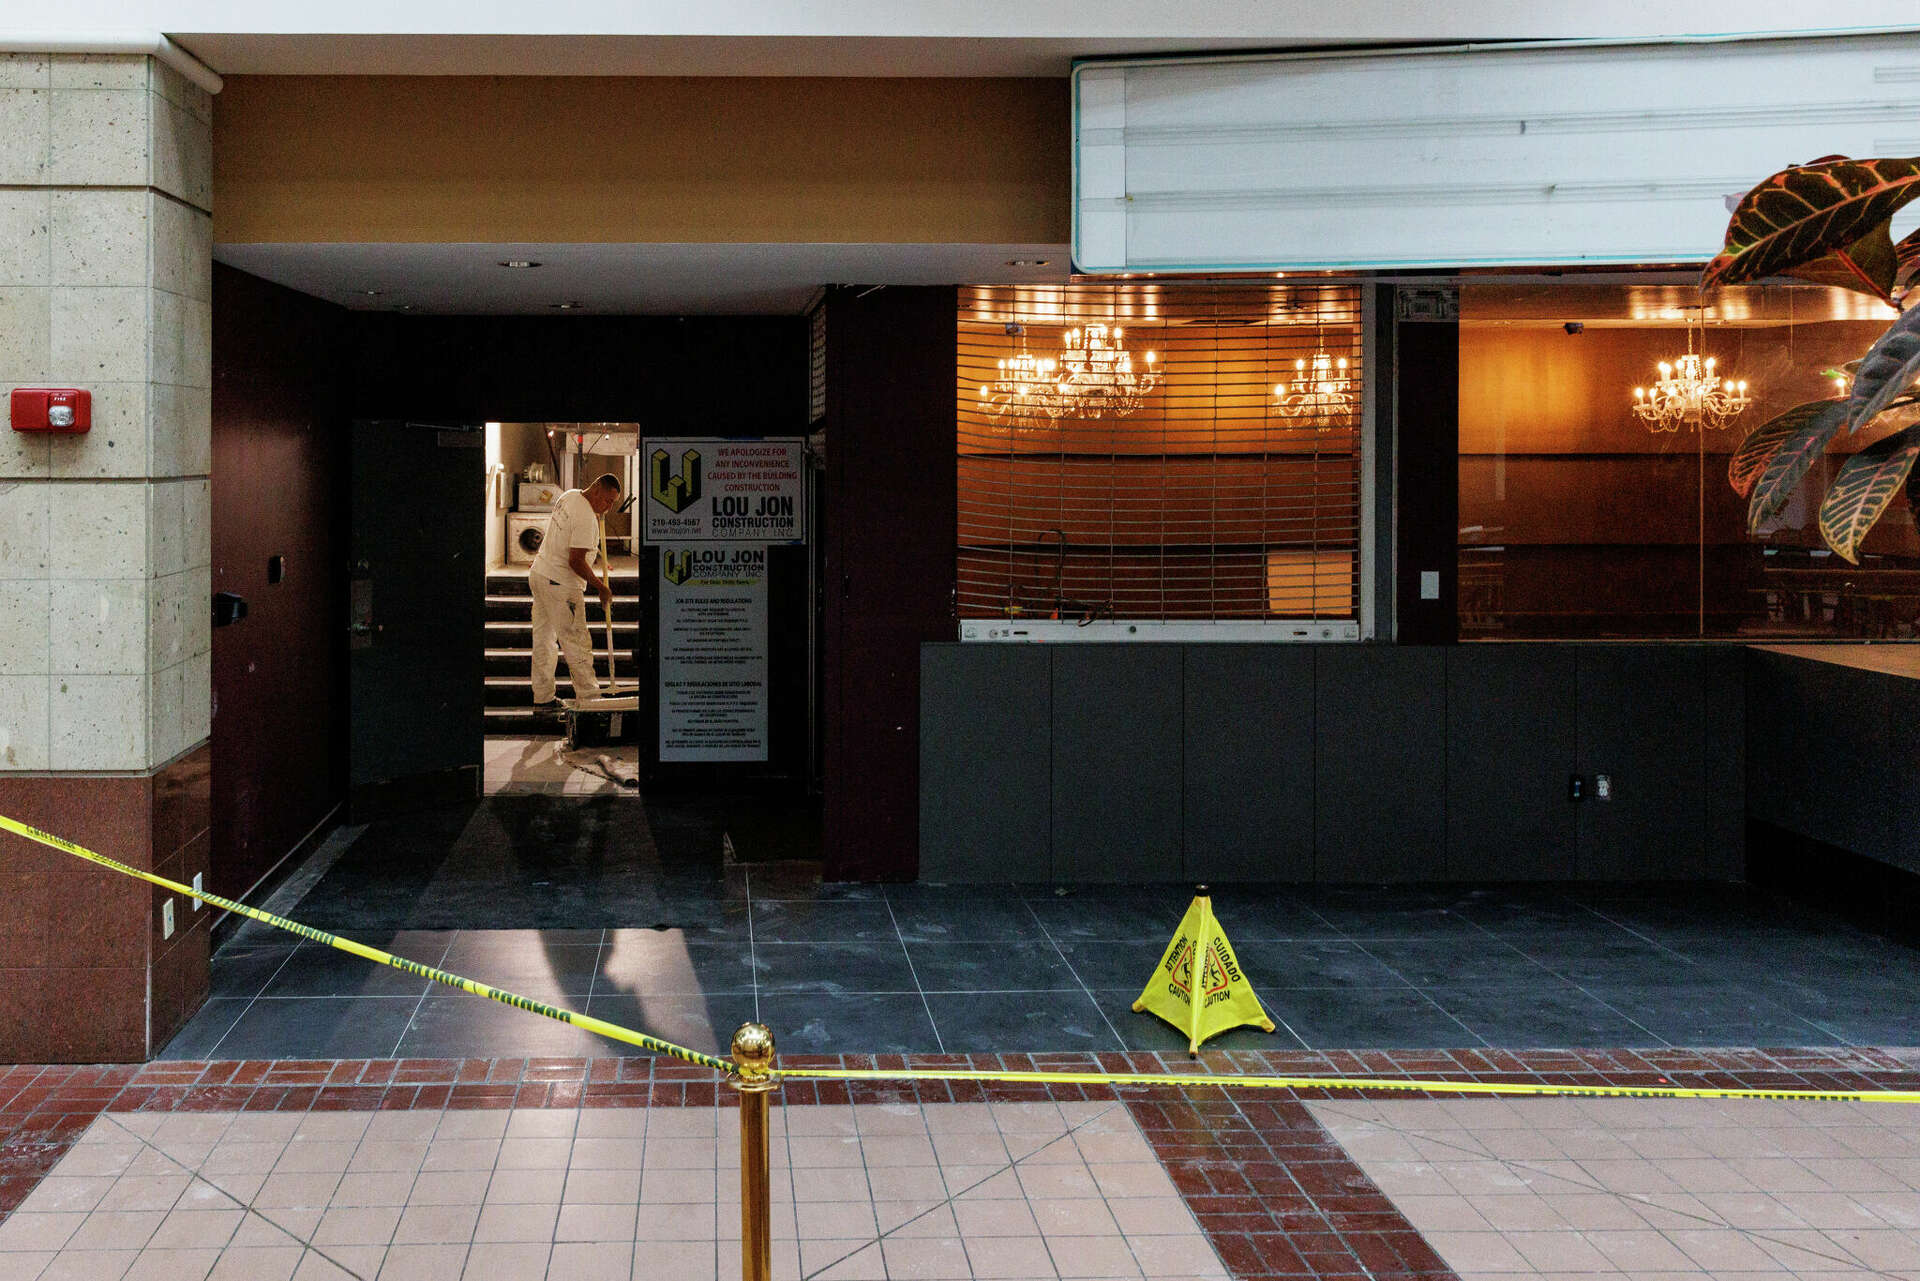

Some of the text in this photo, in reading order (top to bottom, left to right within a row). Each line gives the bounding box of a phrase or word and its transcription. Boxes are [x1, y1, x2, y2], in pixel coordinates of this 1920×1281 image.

[718, 448, 787, 456] WE APOLOGIZE FOR
[715, 460, 790, 468] ANY INCONVENIENCE
[707, 471, 798, 480] CAUSED BY THE BUILDING
[724, 483, 781, 491] CONSTRUCTION
[712, 496, 793, 516] LOU JON
[712, 517, 793, 528] CONSTRUCTION
[712, 528, 766, 537] COMPANY
[693, 550, 764, 563] LOU JON
[1165, 934, 1188, 972] ATTENTION
[1214, 936, 1241, 982] CUIDADO
[1168, 983, 1191, 1007] CAUTION
